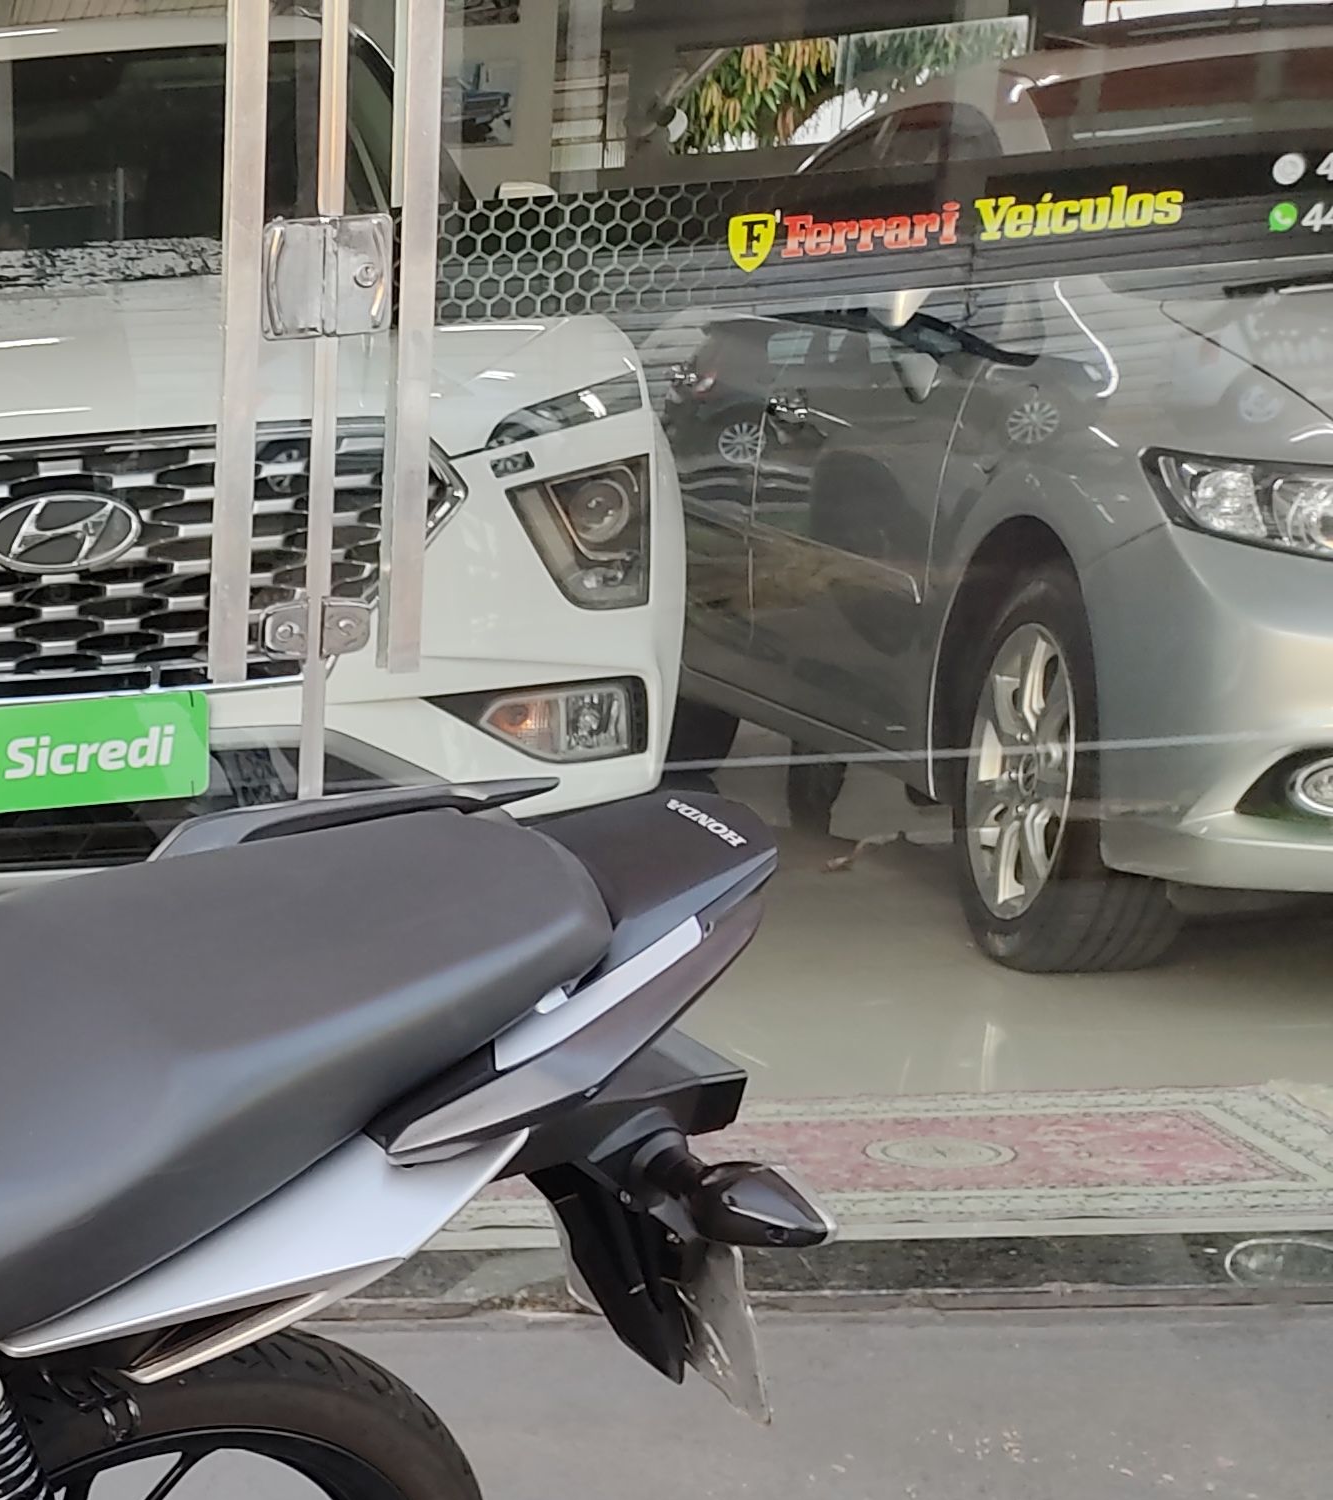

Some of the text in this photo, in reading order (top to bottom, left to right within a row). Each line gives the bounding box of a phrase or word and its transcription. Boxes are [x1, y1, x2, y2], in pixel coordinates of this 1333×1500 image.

[780, 202, 961, 258] Ferrari
[4, 724, 176, 780] Sicredi
[666, 798, 748, 848] HONDA
